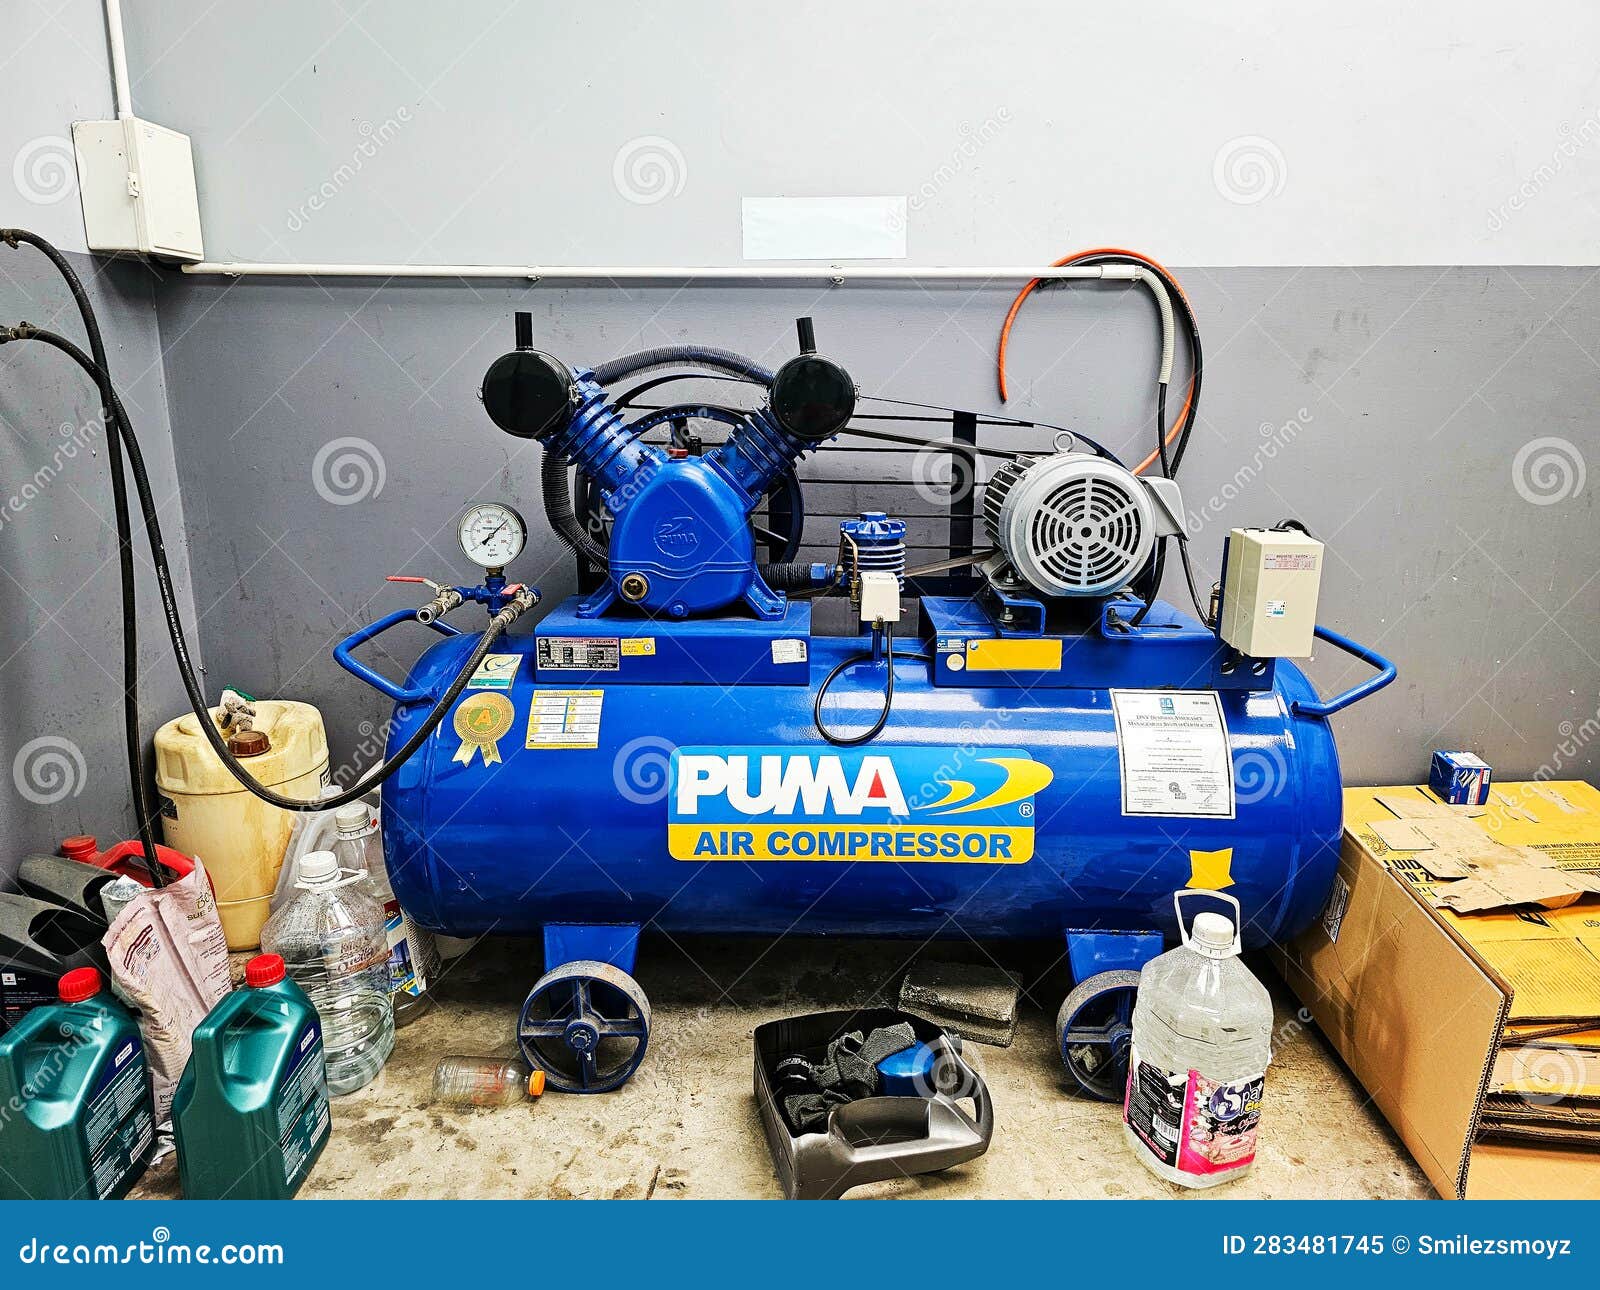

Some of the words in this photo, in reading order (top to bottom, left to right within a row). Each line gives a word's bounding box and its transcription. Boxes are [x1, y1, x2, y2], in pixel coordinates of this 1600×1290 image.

[473, 708, 493, 726] A
[676, 755, 910, 816] PUMA
[693, 831, 755, 856] AIR
[767, 831, 1013, 859] COMPRESSOR
